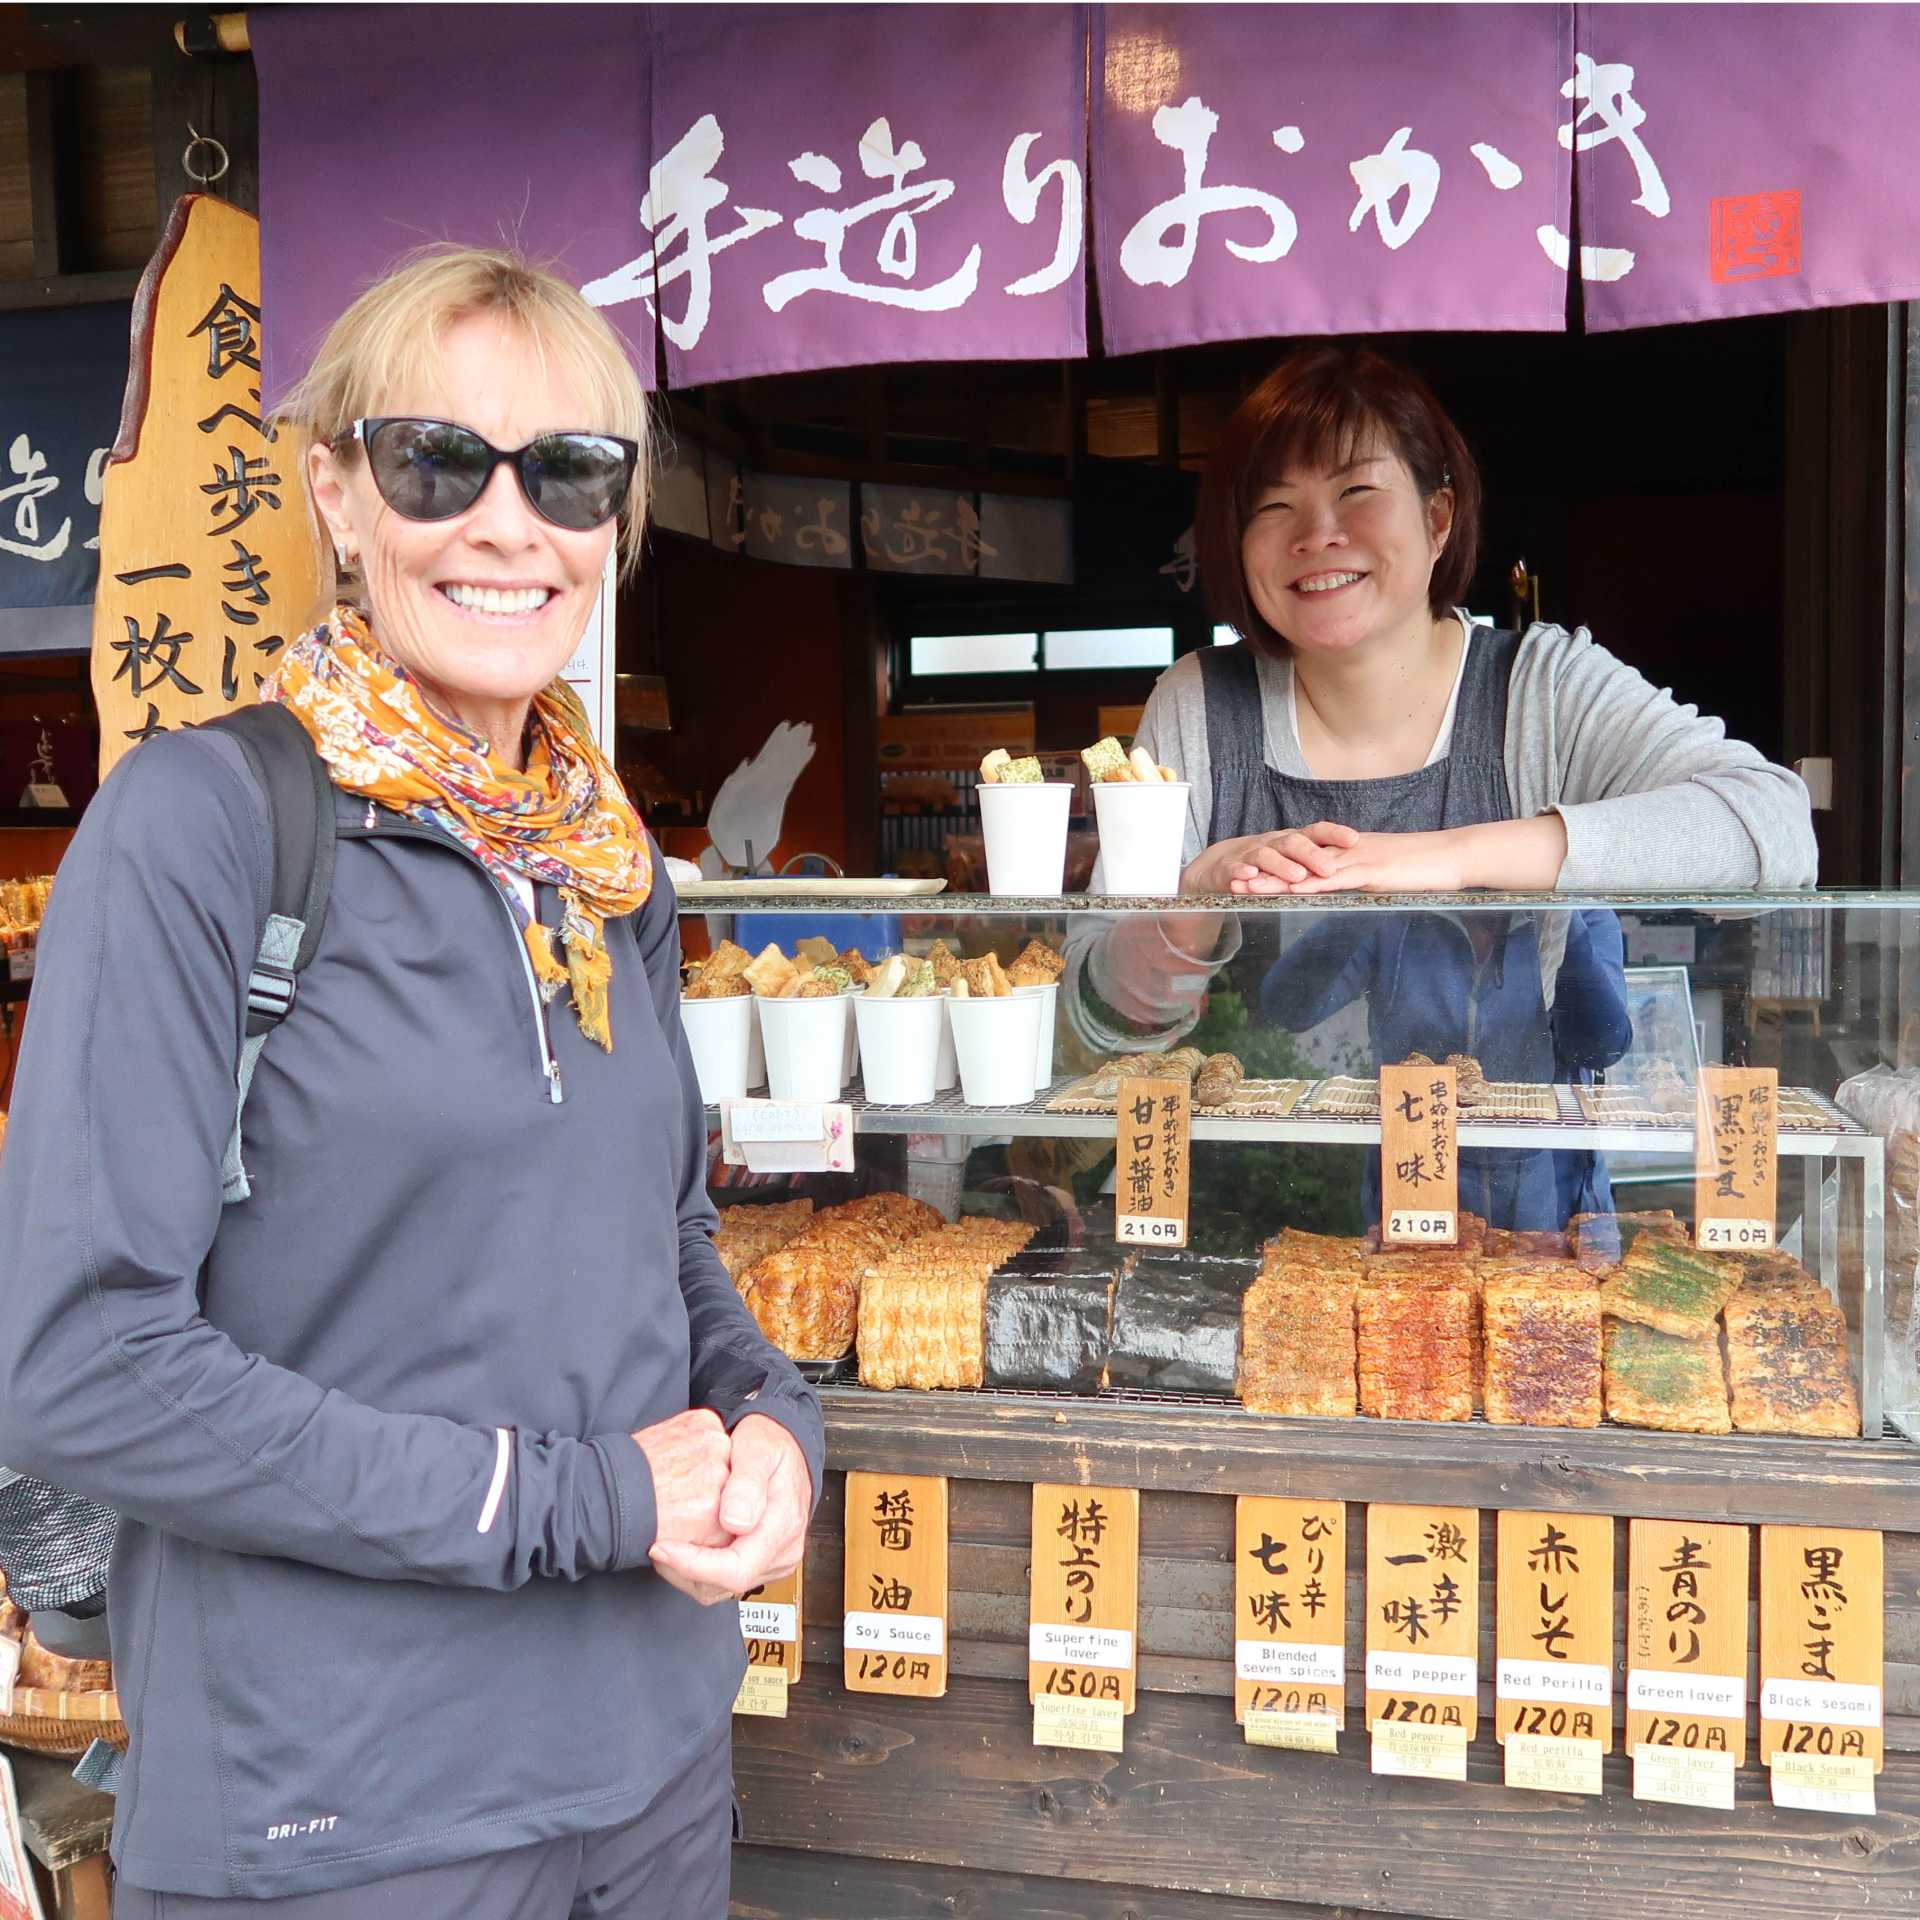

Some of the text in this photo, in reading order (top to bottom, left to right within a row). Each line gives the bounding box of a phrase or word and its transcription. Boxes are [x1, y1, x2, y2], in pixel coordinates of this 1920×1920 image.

[1395, 1090, 1431, 1188] 七味
[1714, 1094, 1745, 1199] 黒ごま
[1124, 1223, 1177, 1238] 210円
[1391, 1218, 1447, 1233] 210円
[1708, 1228, 1767, 1243] 210円
[870, 1490, 914, 1612] 醤油
[1056, 1498, 1108, 1623] 特上のり
[1300, 1515, 1337, 1618] ぴり辛
[1423, 1522, 1467, 1625] 激辛
[1249, 1532, 1292, 1634] 七味
[1528, 1524, 1580, 1659] 赤しそ
[1382, 1553, 1429, 1644] 一味
[1659, 1536, 1712, 1664] 青のり
[1801, 1547, 1847, 1681] 黒ごま
[745, 1624, 780, 1634] sauce
[855, 1625, 931, 1642] Soy Sauce
[859, 1653, 930, 1680] 120円
[1065, 1647, 1099, 1660] laver
[1262, 1648, 1317, 1662] Blended
[1243, 1663, 1281, 1674] seven
[1375, 1665, 1467, 1682] Red pepper
[1504, 1673, 1603, 1691] Red Perilla
[1046, 1668, 1120, 1700] 150円
[1250, 1686, 1327, 1713] 120円
[1381, 1698, 1462, 1726] 120円
[1769, 1693, 1811, 1707] Black
[1514, 1706, 1593, 1737] 120円
[1646, 1717, 1727, 1752] 120円
[1782, 1723, 1865, 1757] 120円
[266, 1815, 338, 1840] DRI-FIT
